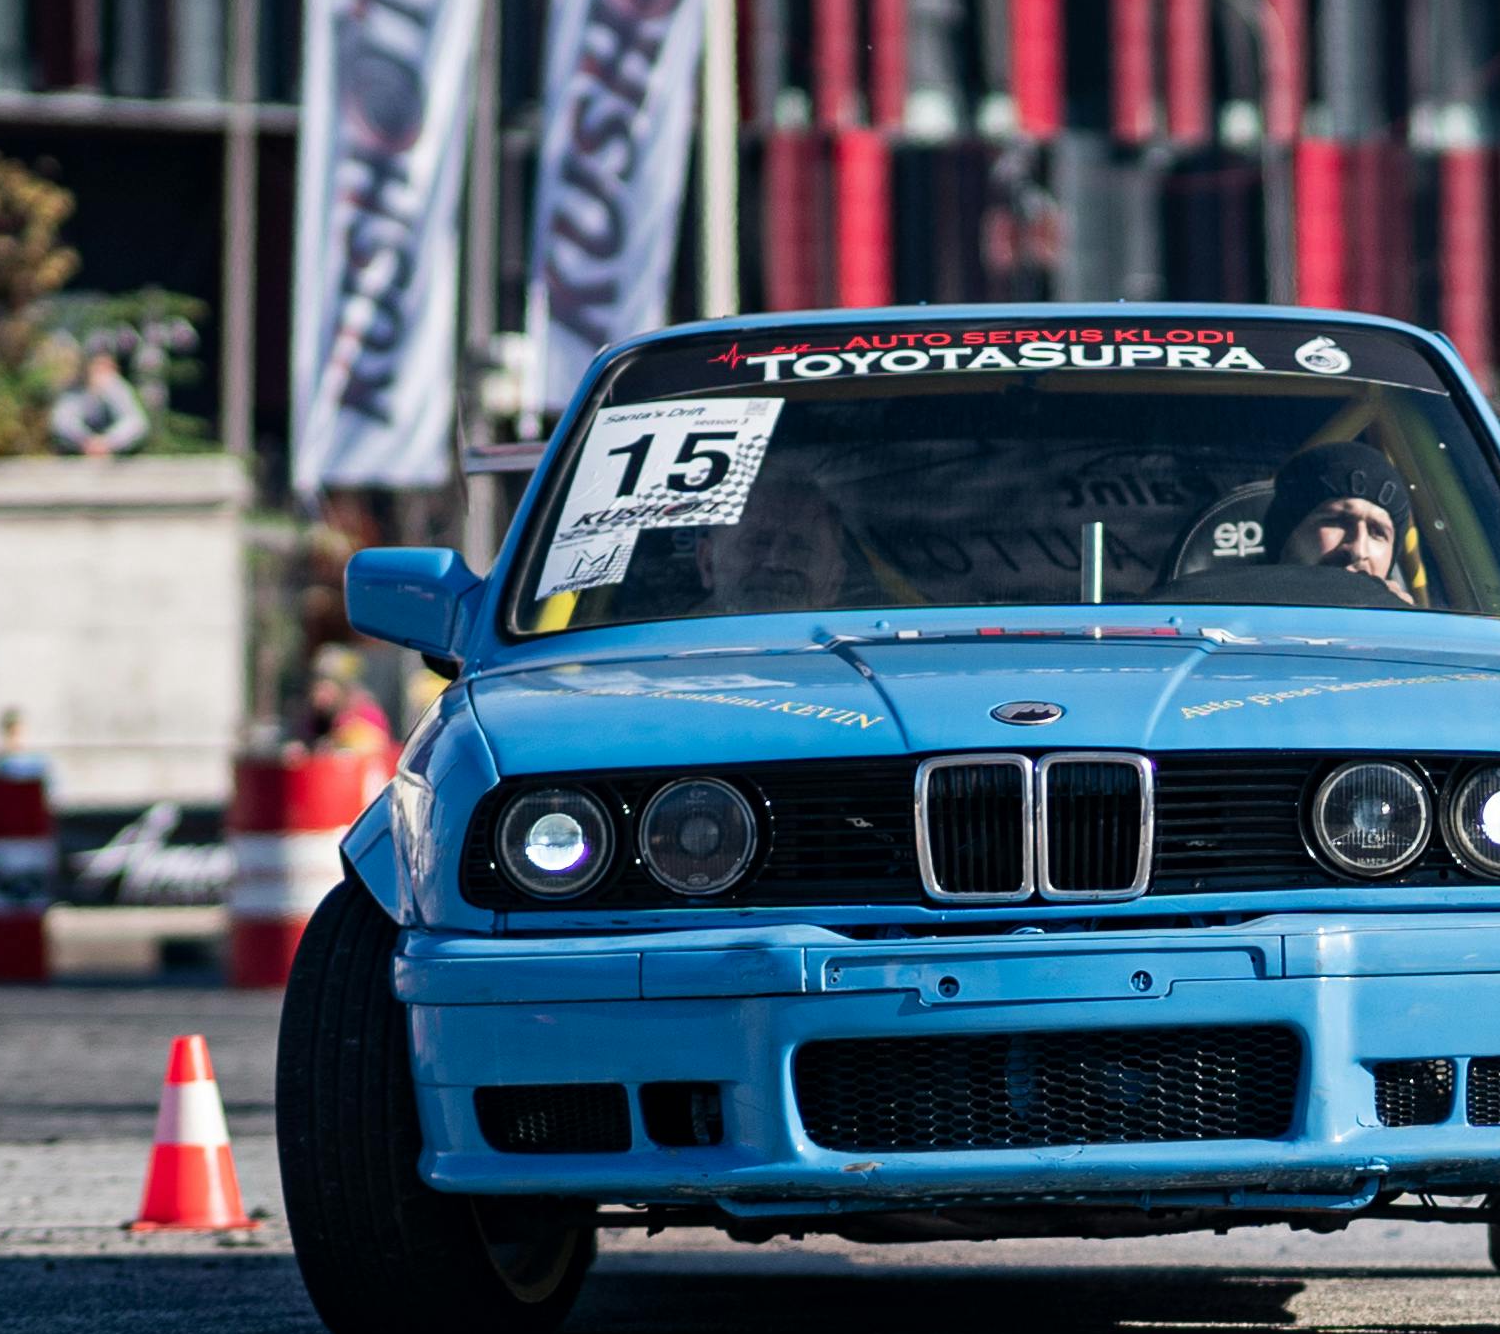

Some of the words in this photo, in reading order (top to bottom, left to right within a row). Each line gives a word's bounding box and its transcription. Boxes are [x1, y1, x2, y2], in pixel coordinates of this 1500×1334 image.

[844, 332, 953, 350] AUTO
[962, 328, 1103, 345] SERVIS
[1114, 329, 1234, 344] KLODI
[667, 406, 706, 418] Drift
[608, 431, 738, 498] 15
[572, 499, 729, 528] KUSHOT
[769, 701, 884, 729] KEVIN
